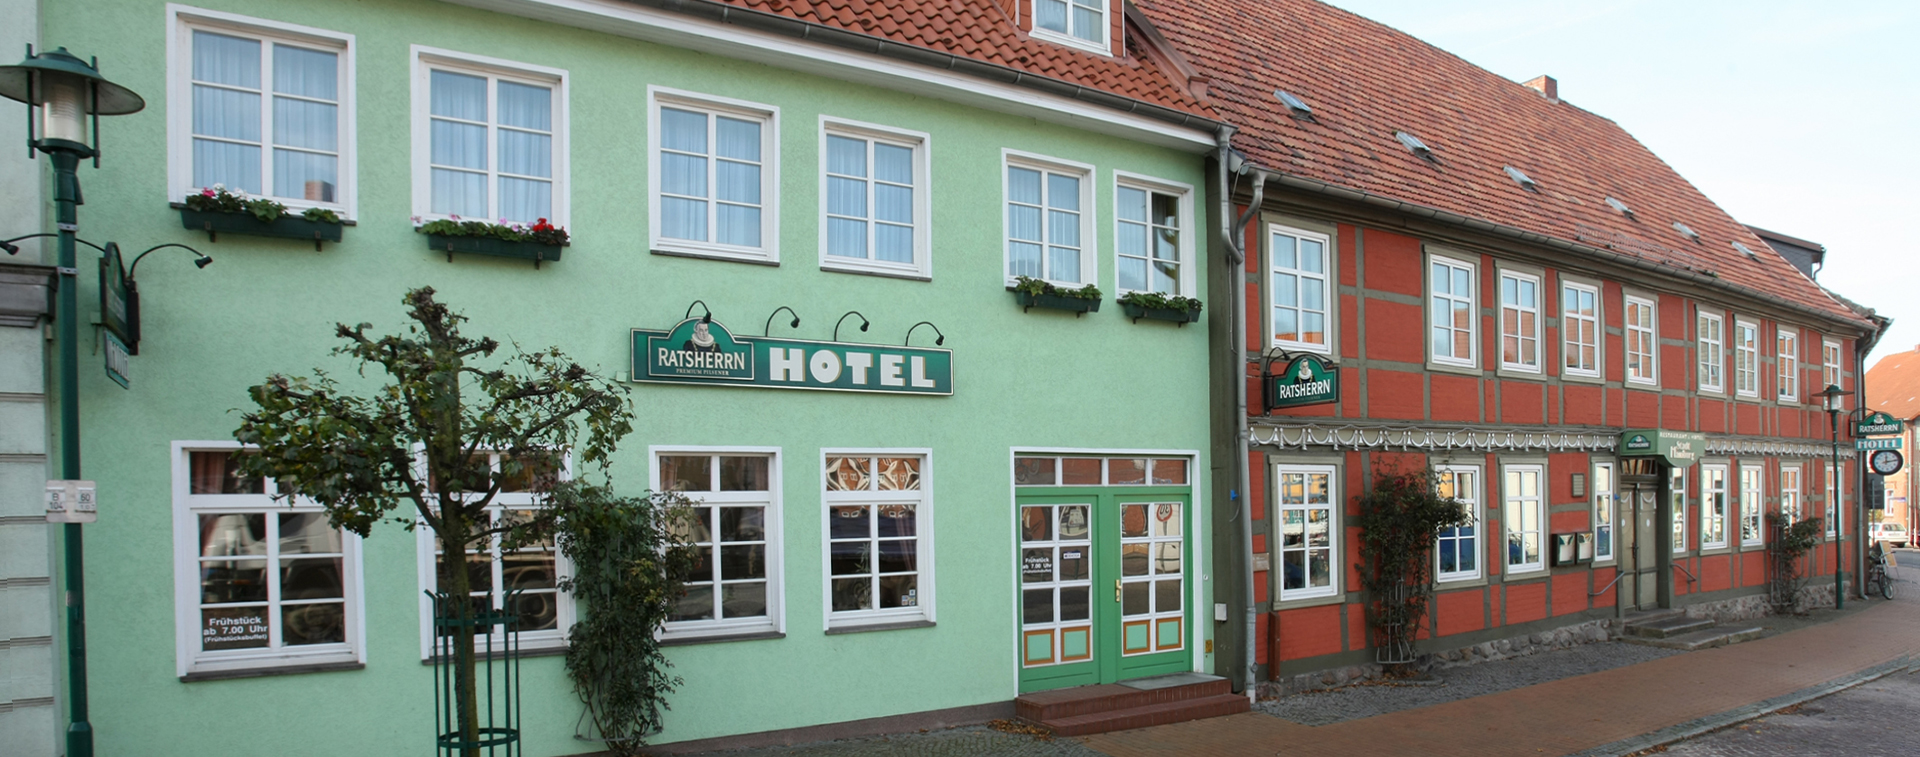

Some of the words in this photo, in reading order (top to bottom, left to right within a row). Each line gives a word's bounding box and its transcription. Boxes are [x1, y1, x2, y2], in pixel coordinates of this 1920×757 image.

[658, 347, 745, 370] RATSHERRN
[769, 347, 936, 388] HOTEL
[1280, 379, 1330, 399] RATSHERRN
[1859, 424, 1898, 433] RATSHERRN
[1857, 439, 1899, 449] HOTEL
[209, 616, 262, 626] Frühstück
[203, 627, 216, 635] ab
[222, 626, 244, 634] 7.00
[249, 625, 268, 633] Uhr
